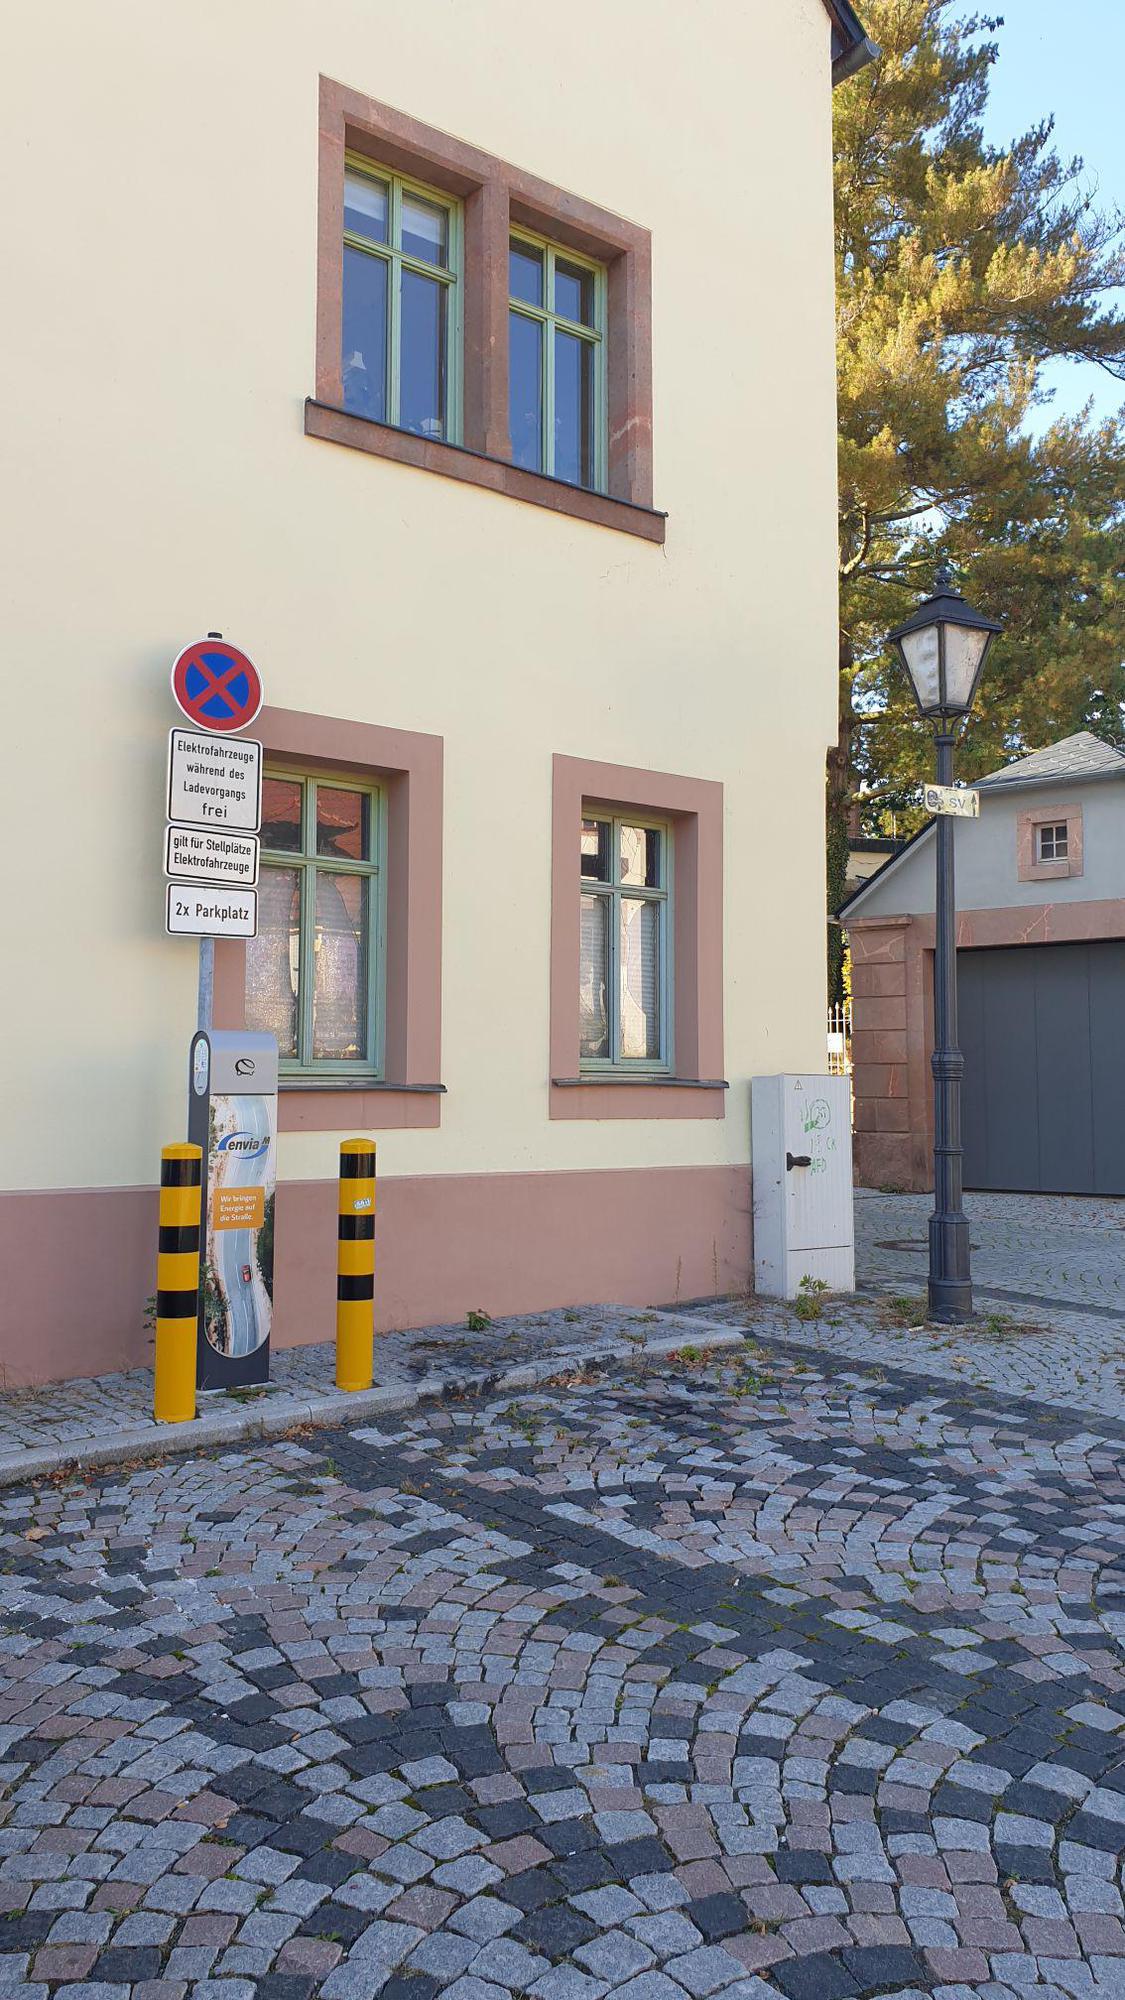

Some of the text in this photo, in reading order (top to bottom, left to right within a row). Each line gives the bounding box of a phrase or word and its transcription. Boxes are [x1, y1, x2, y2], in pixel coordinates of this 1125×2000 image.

[177, 740, 254, 764] Elektrofahrzeuge
[186, 762, 245, 780] während des
[183, 780, 246, 802] Ladevorgangs
[202, 803, 227, 818] frei
[173, 835, 251, 855] gilt für Stellplätze
[174, 852, 250, 874] Elektrofahrzeuge
[176, 902, 249, 922] 2x Parkplatz
